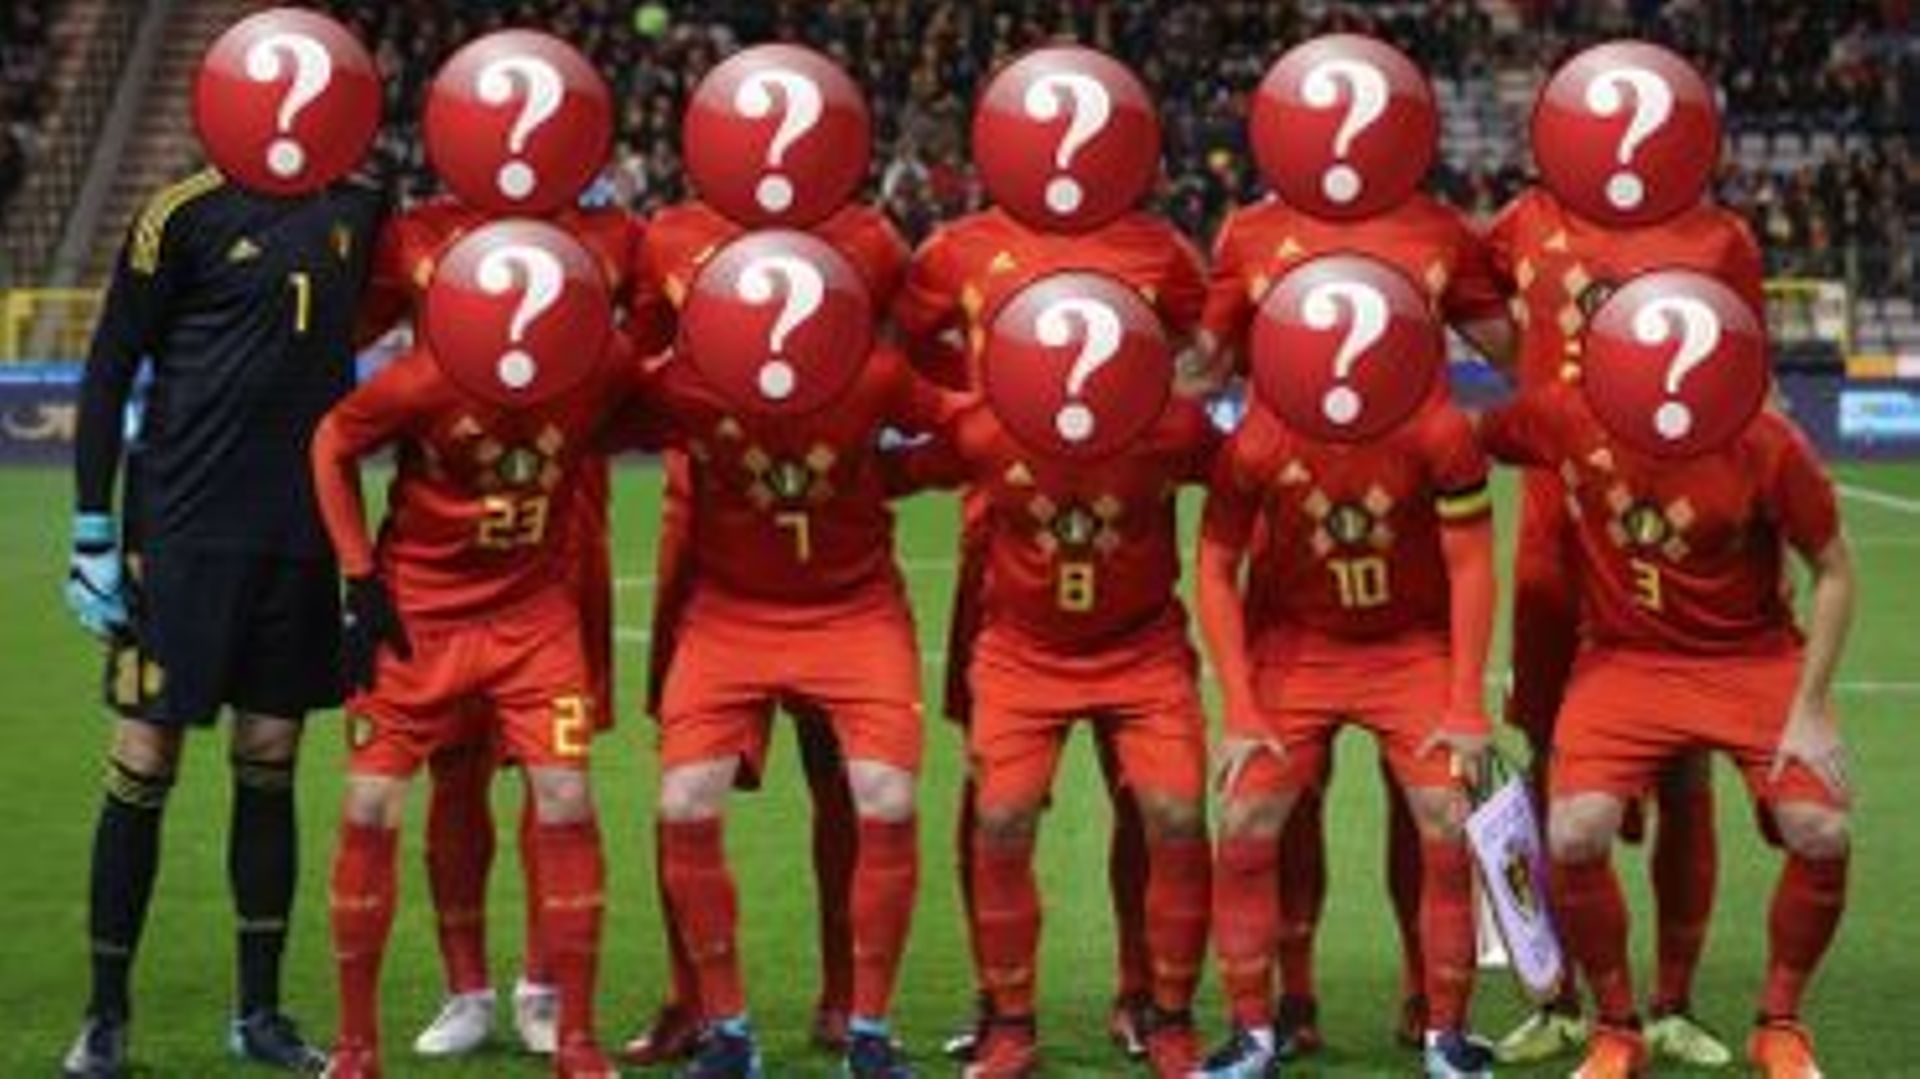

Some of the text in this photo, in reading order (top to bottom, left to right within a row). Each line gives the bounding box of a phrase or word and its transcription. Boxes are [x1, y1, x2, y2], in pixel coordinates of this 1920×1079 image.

[479, 496, 550, 547] 23
[776, 512, 809, 562] 7
[1059, 562, 1095, 611] 8
[1328, 557, 1388, 608] 10
[1631, 558, 1662, 611] 3
[552, 696, 596, 756] 2
